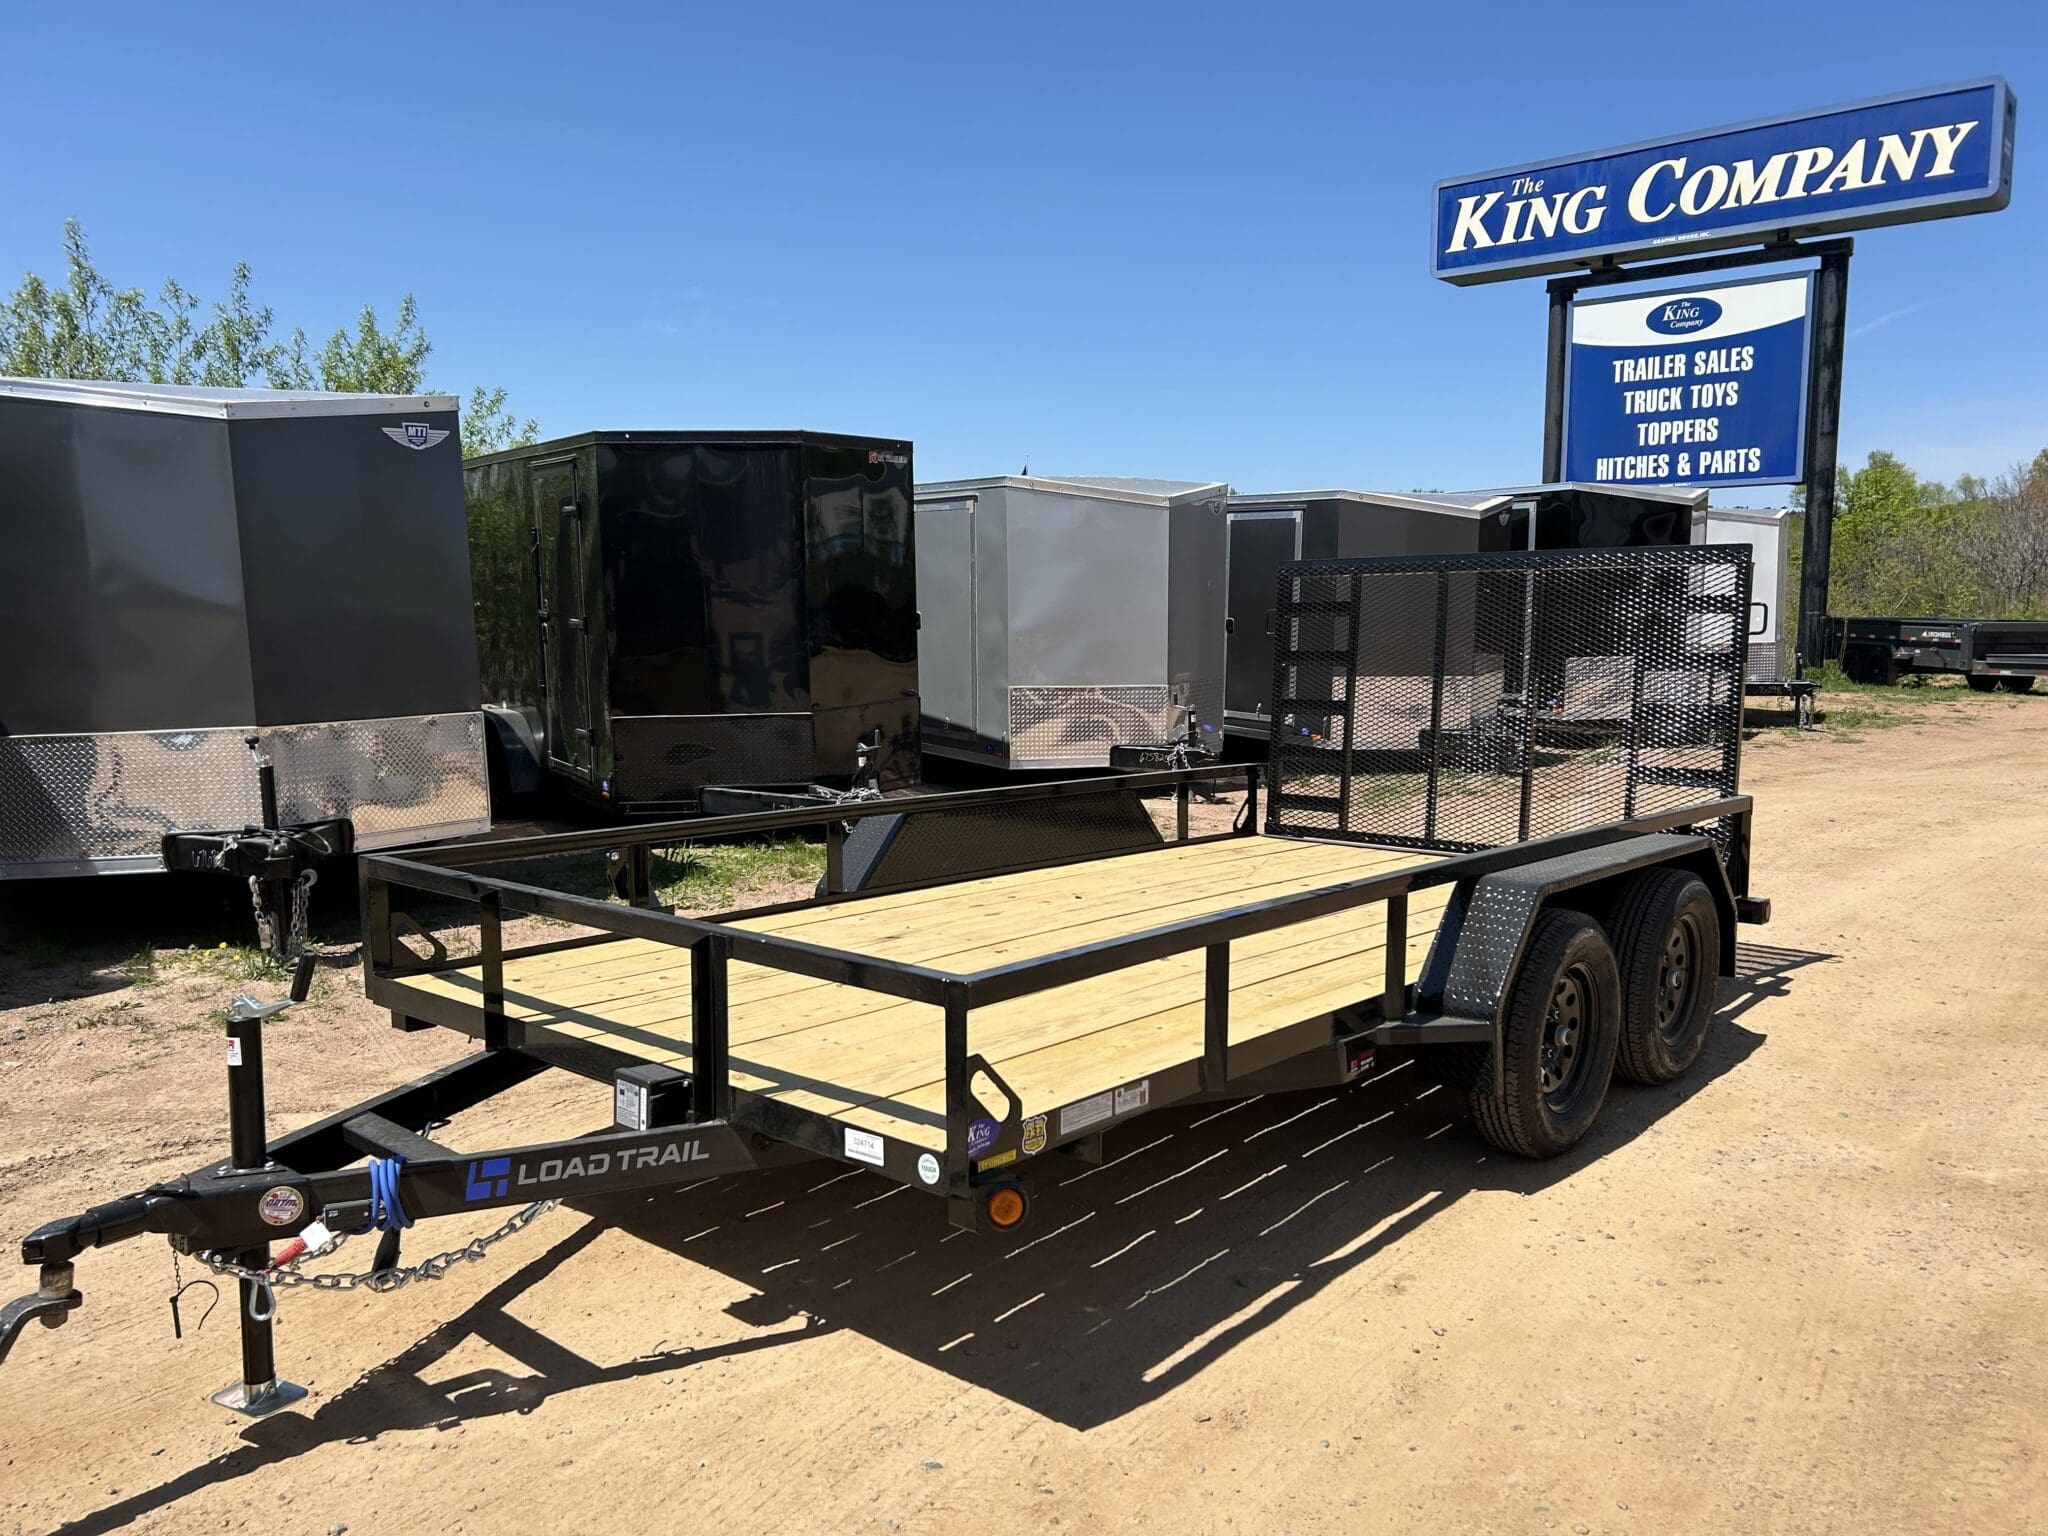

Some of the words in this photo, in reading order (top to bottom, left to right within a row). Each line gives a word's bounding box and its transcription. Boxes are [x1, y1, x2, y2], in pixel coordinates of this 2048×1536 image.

[1445, 185, 1608, 254] KING
[1627, 120, 1980, 224] COMPANY
[1512, 176, 1545, 197] The
[1662, 305, 1700, 322] KING
[1670, 319, 1704, 329] Company
[1612, 353, 1687, 384] TRAILER
[1694, 345, 1755, 376] SALES
[1624, 386, 1683, 414] TRUCK
[1690, 381, 1739, 409] TOYS
[407, 426, 427, 437] MTI
[1637, 417, 1719, 446] TOPPERS
[1596, 453, 1670, 481] HITCHES
[1677, 451, 1692, 477] &
[1699, 447, 1761, 475] PARTS
[968, 1125, 991, 1142] KING
[517, 1153, 611, 1185] LOAD
[617, 1140, 710, 1171] TRAIL
